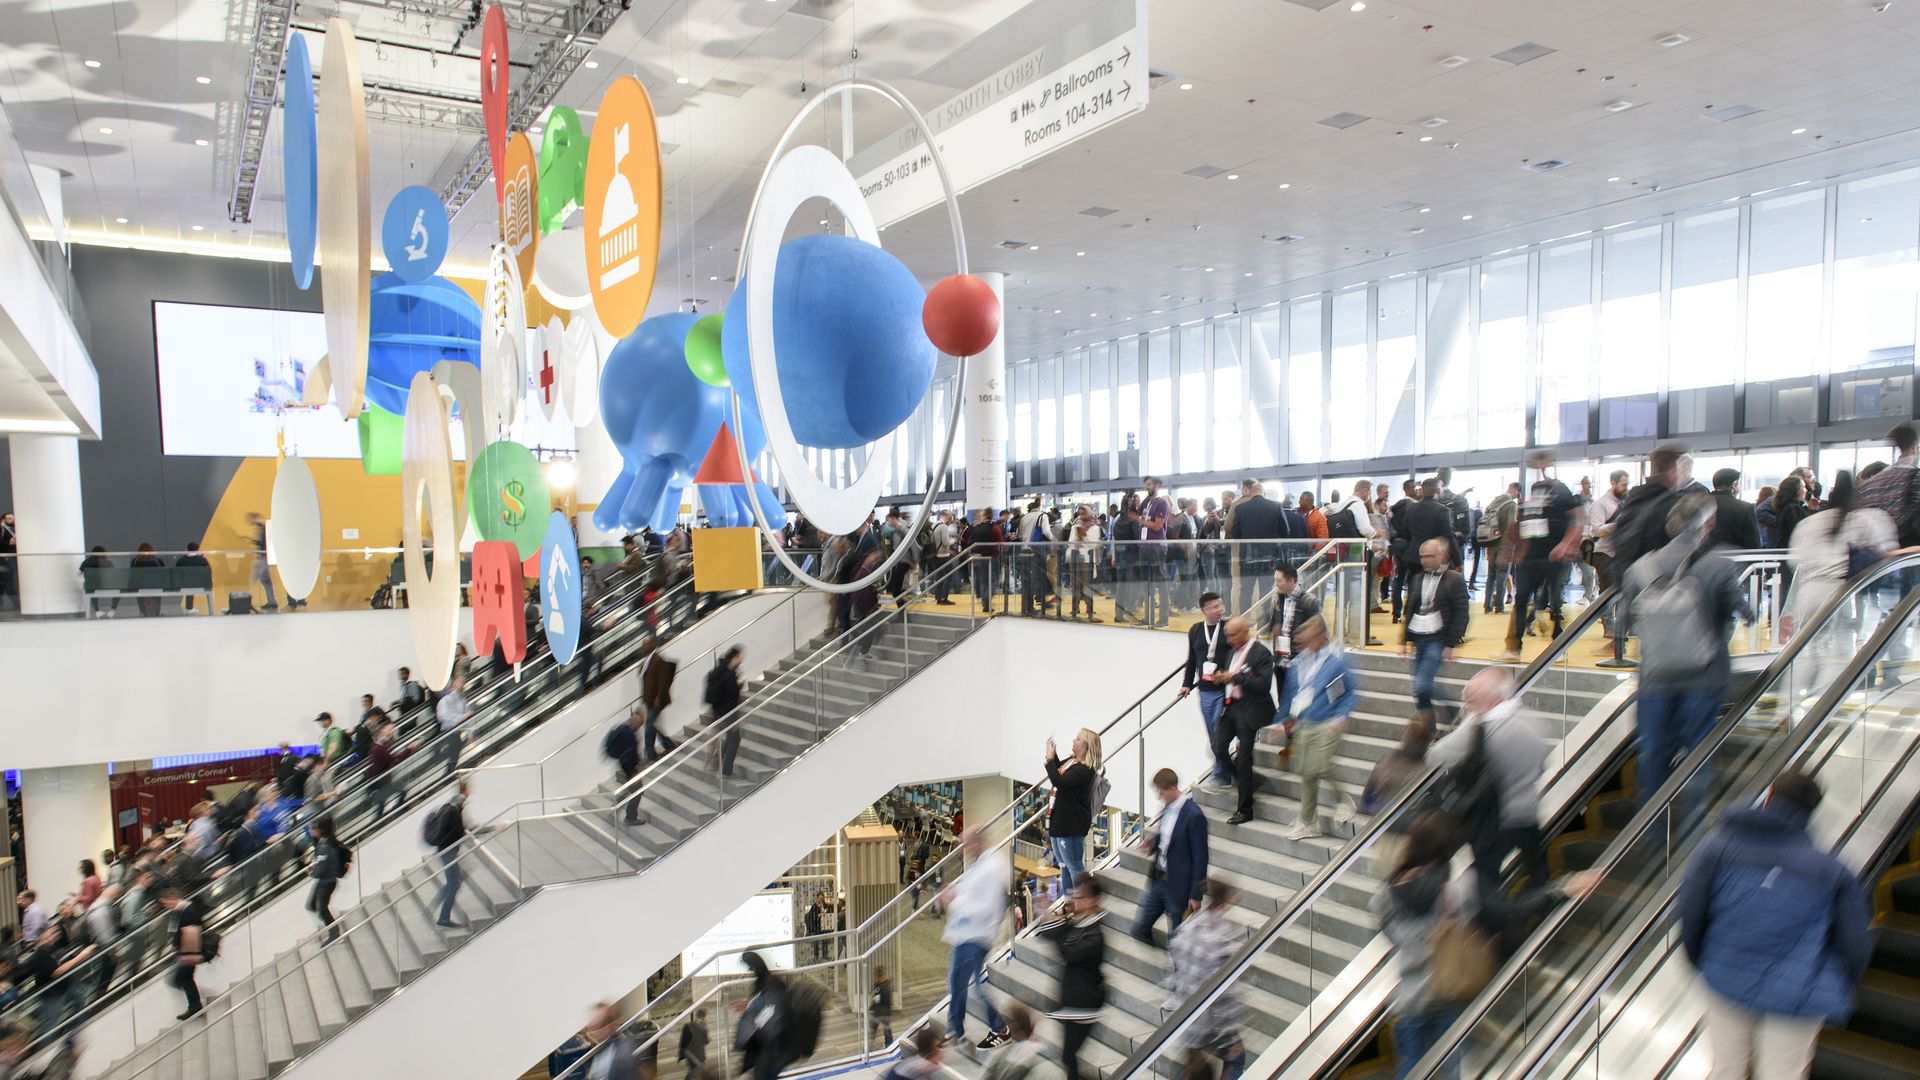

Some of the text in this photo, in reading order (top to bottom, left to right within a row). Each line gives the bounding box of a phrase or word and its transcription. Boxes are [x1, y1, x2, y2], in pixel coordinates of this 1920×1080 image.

[947, 82, 991, 122] SOUTH
[996, 52, 1043, 96] LOBBY
[1054, 60, 1113, 101] Ballrooms
[1024, 88, 1113, 147] Rooms 104-314
[884, 162, 910, 188] 50-103
[144, 771, 196, 785] Community
[197, 768, 228, 778] Corner
